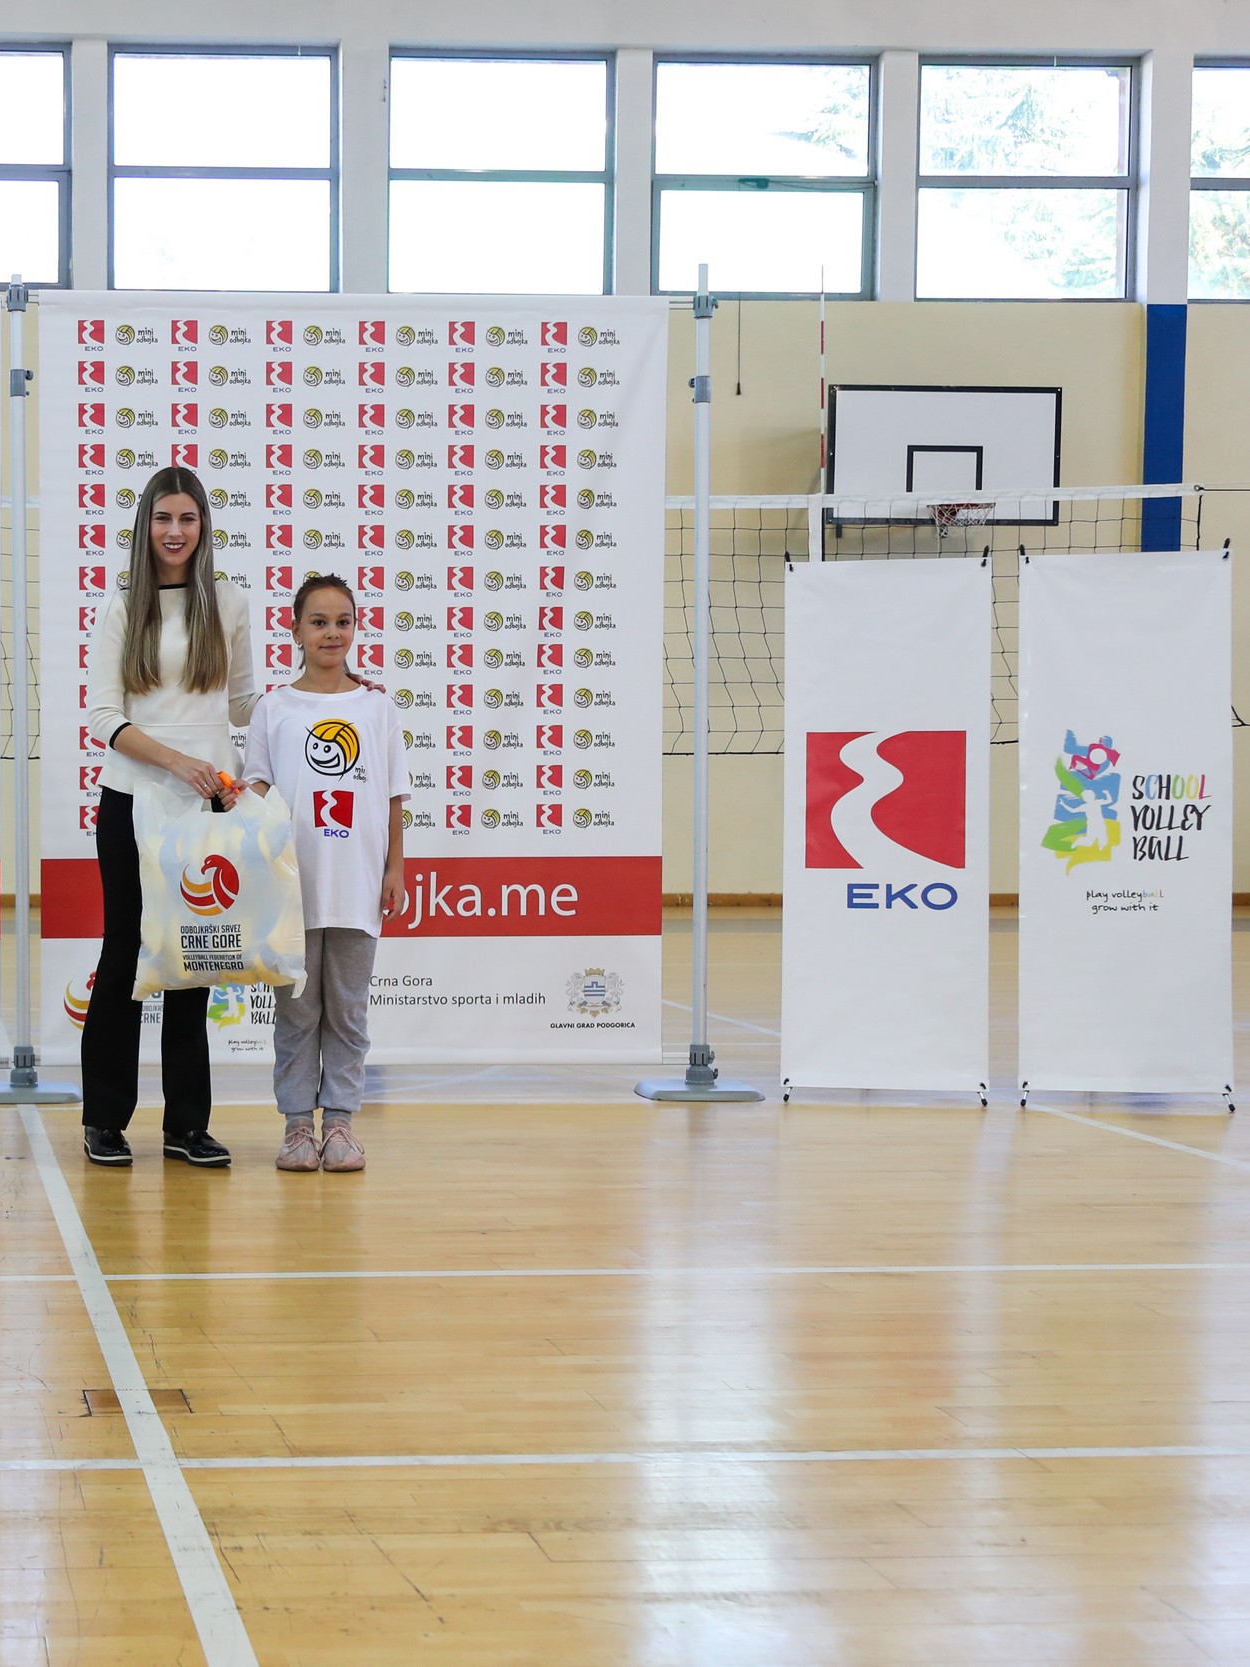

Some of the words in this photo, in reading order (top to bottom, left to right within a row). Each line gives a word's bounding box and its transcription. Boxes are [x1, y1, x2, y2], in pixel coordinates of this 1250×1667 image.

[454, 346, 475, 354] EKO
[364, 632, 384, 640] EKO
[272, 668, 293, 676] EKO
[1132, 774, 1211, 800] SCHOOL
[1130, 804, 1211, 831] VOLLEY
[324, 829, 350, 838] EKO
[1132, 835, 1189, 861] BALL
[847, 883, 958, 910] EKO
[1087, 890, 1108, 902] play
[1112, 890, 1163, 902] volleyball
[1092, 904, 1118, 914] grow
[1121, 902, 1146, 912] with
[1149, 902, 1159, 912] it
[180, 924, 220, 934] ODBOJKAŠKI
[221, 924, 241, 933] SAVEZ
[181, 935, 209, 948] CRNE
[212, 934, 242, 948] GORE
[184, 962, 244, 972] MONTENEGRO
[370, 976, 398, 987] Crna
[403, 975, 432, 986] Gora
[370, 994, 448, 1006] Ministarstvo
[452, 995, 491, 1007] sporta
[503, 993, 545, 1004] mladih
